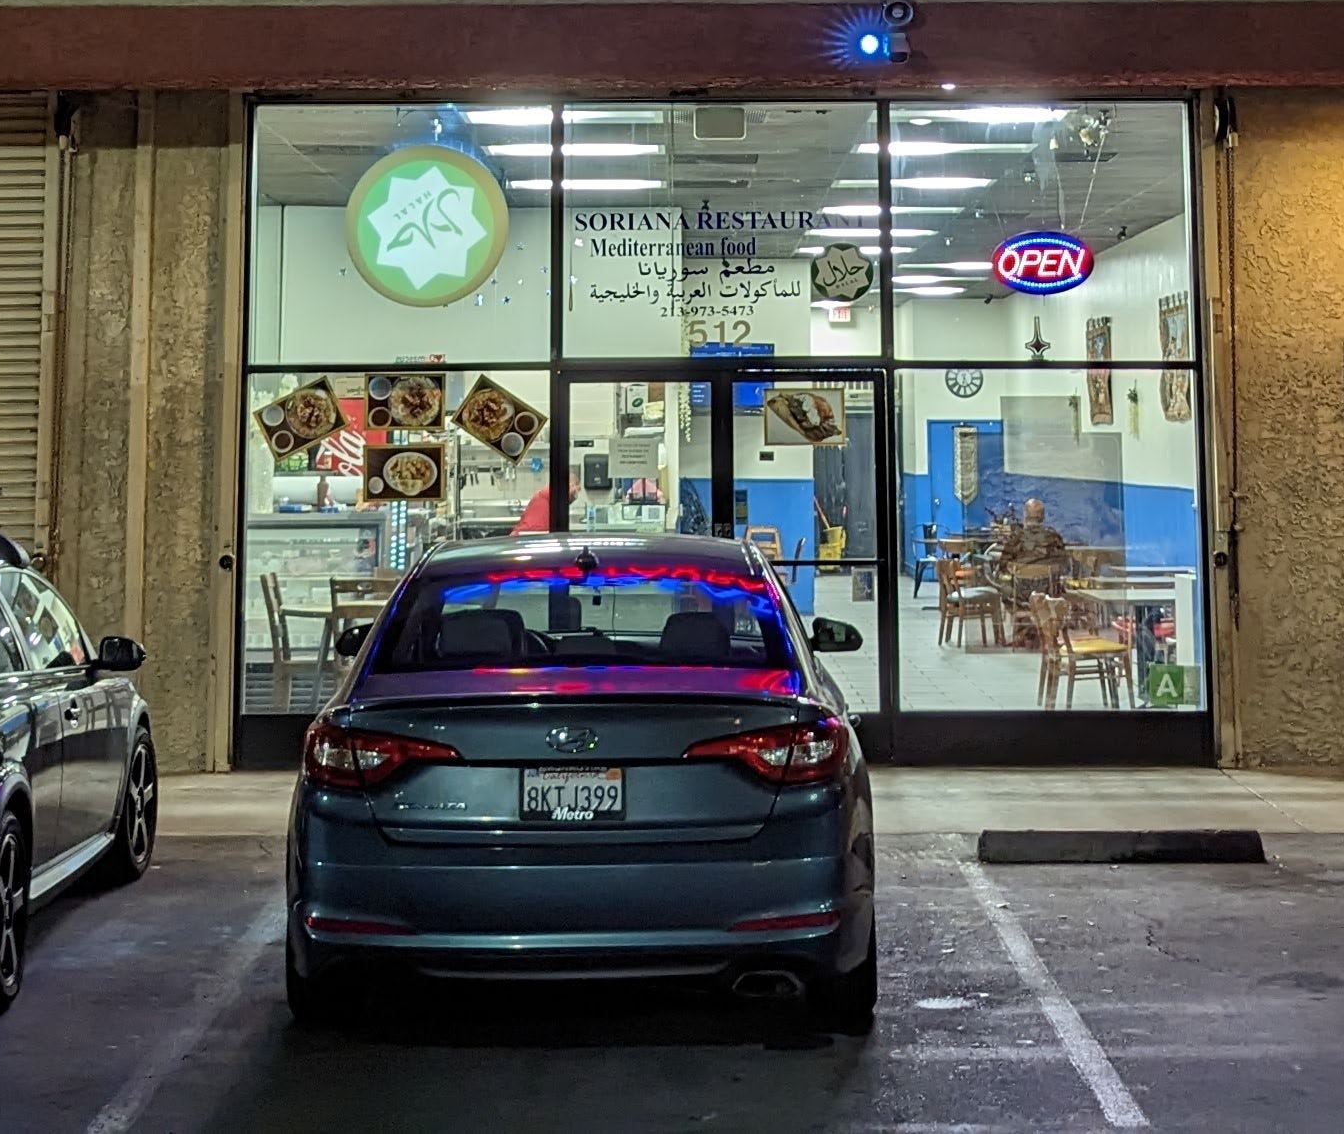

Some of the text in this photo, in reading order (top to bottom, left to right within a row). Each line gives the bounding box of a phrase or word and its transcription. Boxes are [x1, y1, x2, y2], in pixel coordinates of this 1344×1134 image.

[574, 211, 865, 232] SORIANA RESTAURANT
[590, 236, 756, 257] Mediterranean food
[998, 249, 1086, 278] OPEN
[666, 280, 712, 305] العربية
[660, 304, 755, 318] 213-973-5473
[686, 319, 753, 347] 512
[1156, 673, 1178, 698] A
[527, 785, 619, 811] 8KTJ399
[551, 806, 594, 821] Metro
